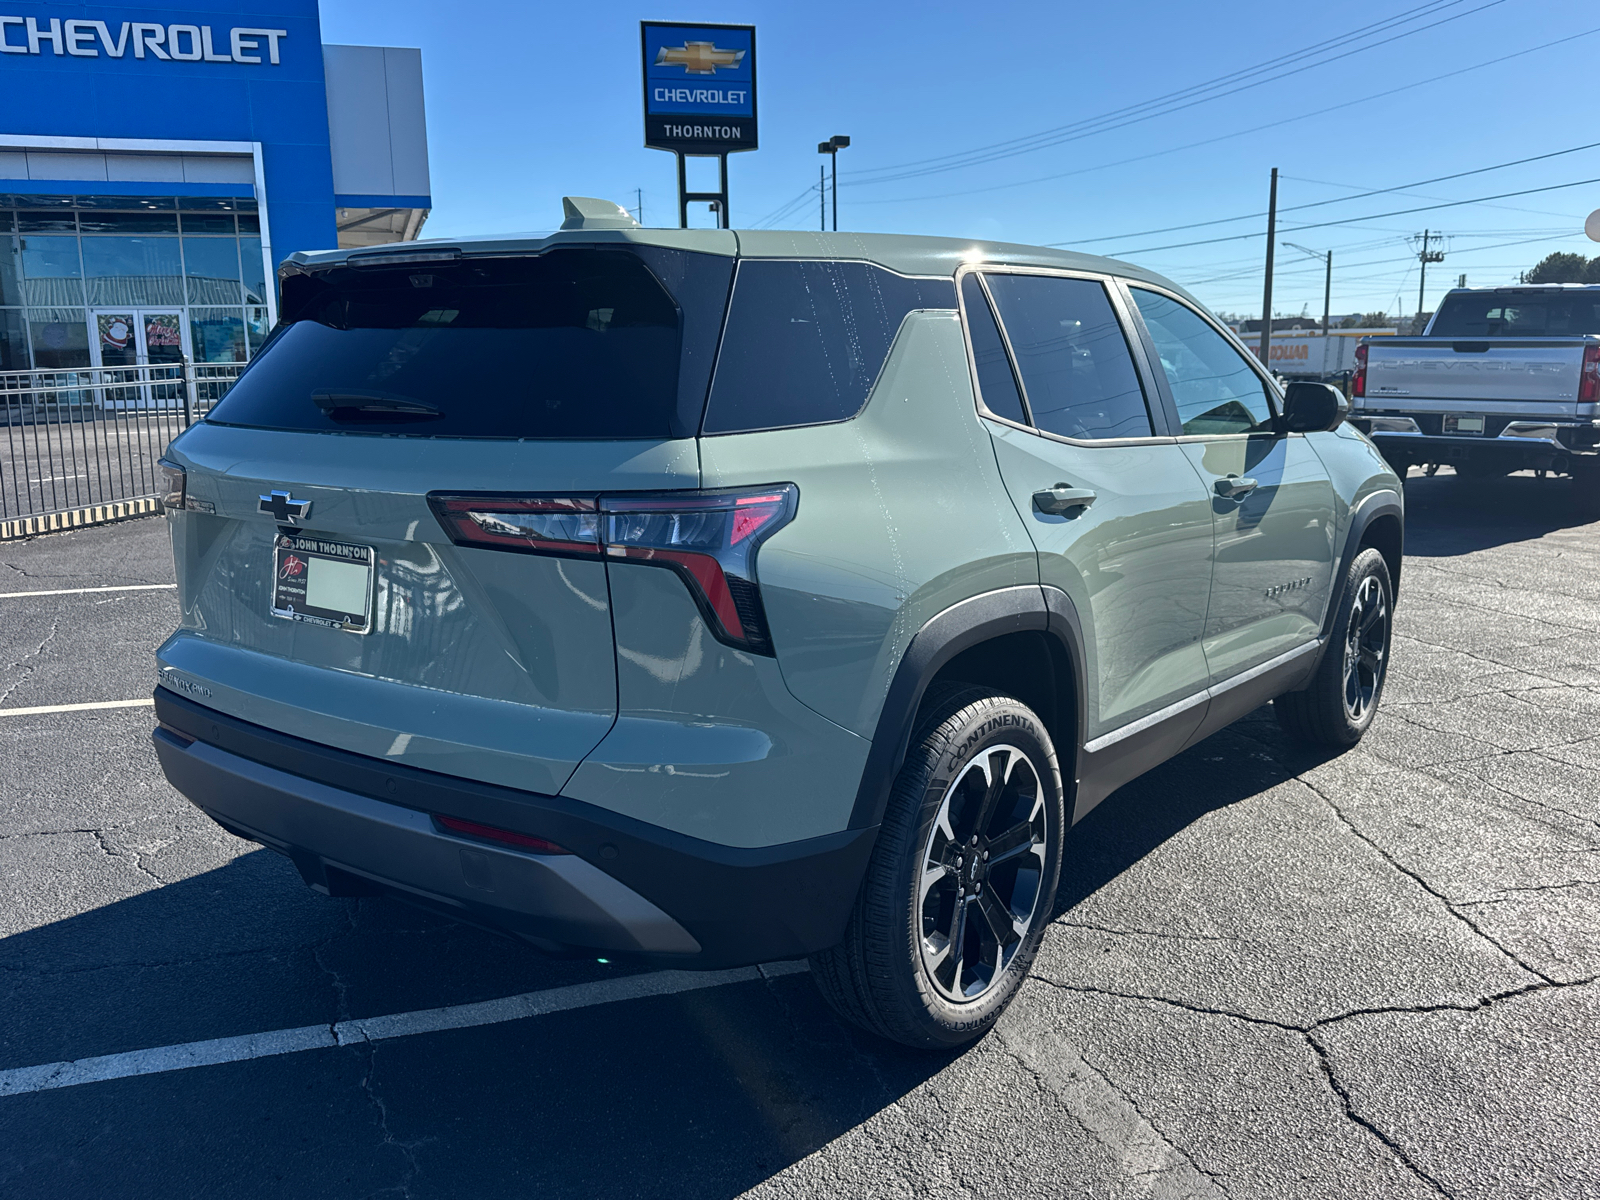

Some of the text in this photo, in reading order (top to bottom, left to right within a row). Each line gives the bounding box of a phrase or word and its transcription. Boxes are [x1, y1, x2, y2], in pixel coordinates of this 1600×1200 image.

[0, 15, 287, 64] CHEVROLET
[654, 88, 747, 104] CHEVROLET
[664, 125, 741, 139] THORNTON
[1379, 359, 1567, 372] CHEVROLET
[295, 538, 368, 559] JOHN THORNTON
[303, 616, 332, 627] CHEVROLET
